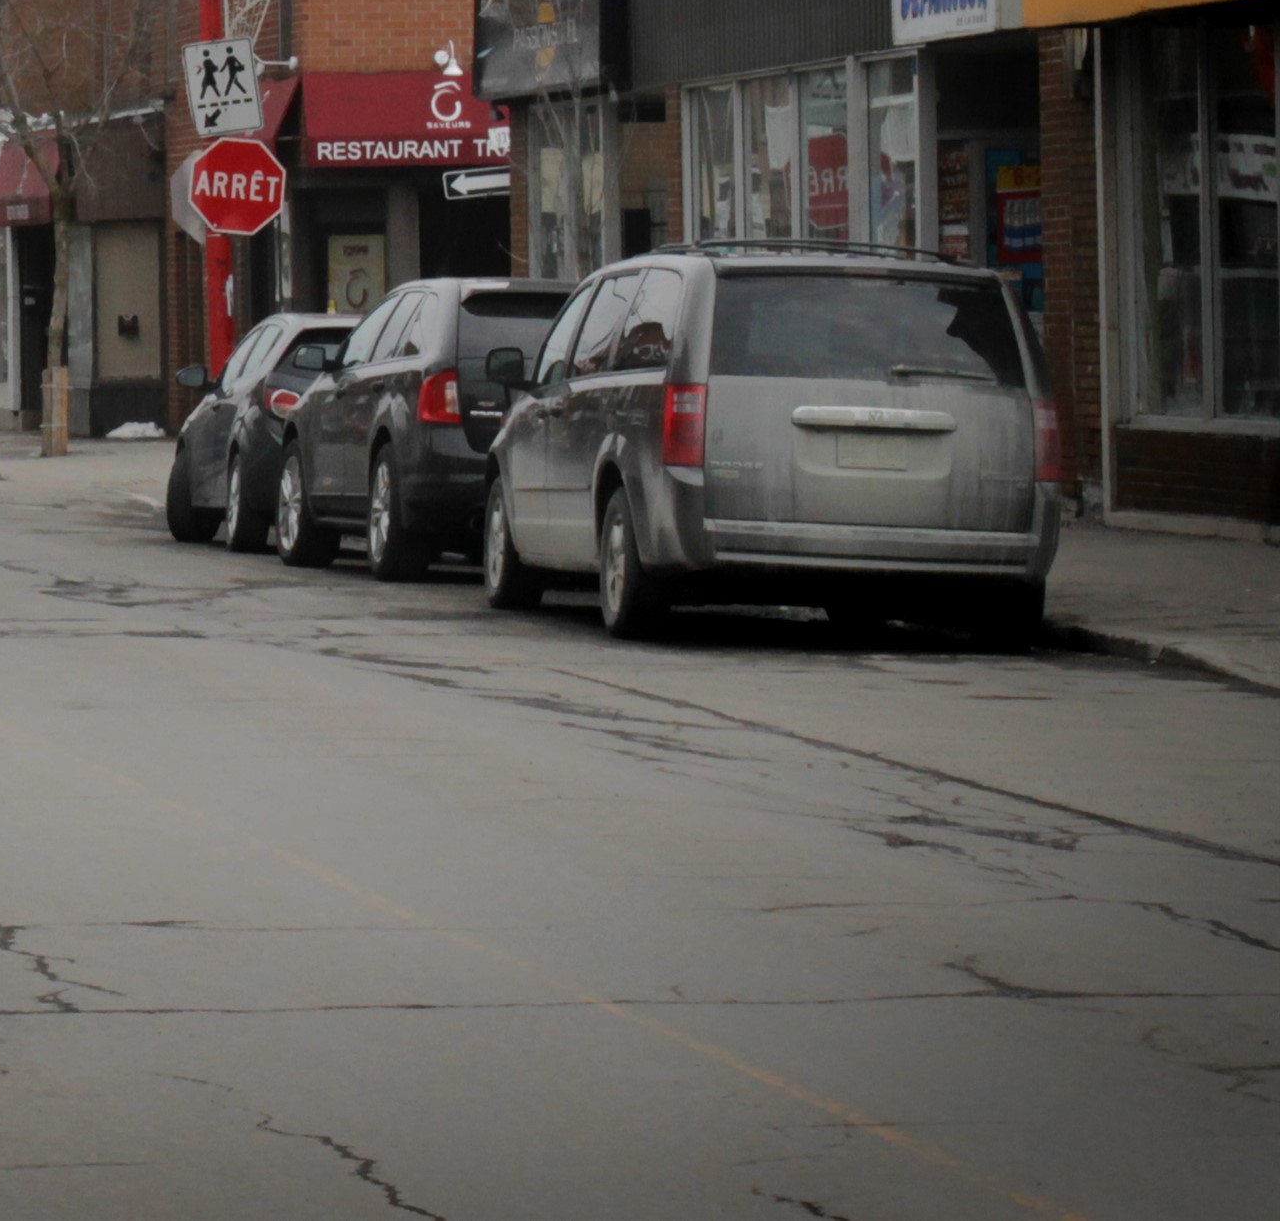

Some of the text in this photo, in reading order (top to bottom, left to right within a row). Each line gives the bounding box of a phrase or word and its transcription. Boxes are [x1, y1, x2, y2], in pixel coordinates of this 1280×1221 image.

[426, 121, 471, 129] SAVEURS
[317, 140, 462, 161] RESTAURANT
[195, 170, 280, 203] ARRÊT
